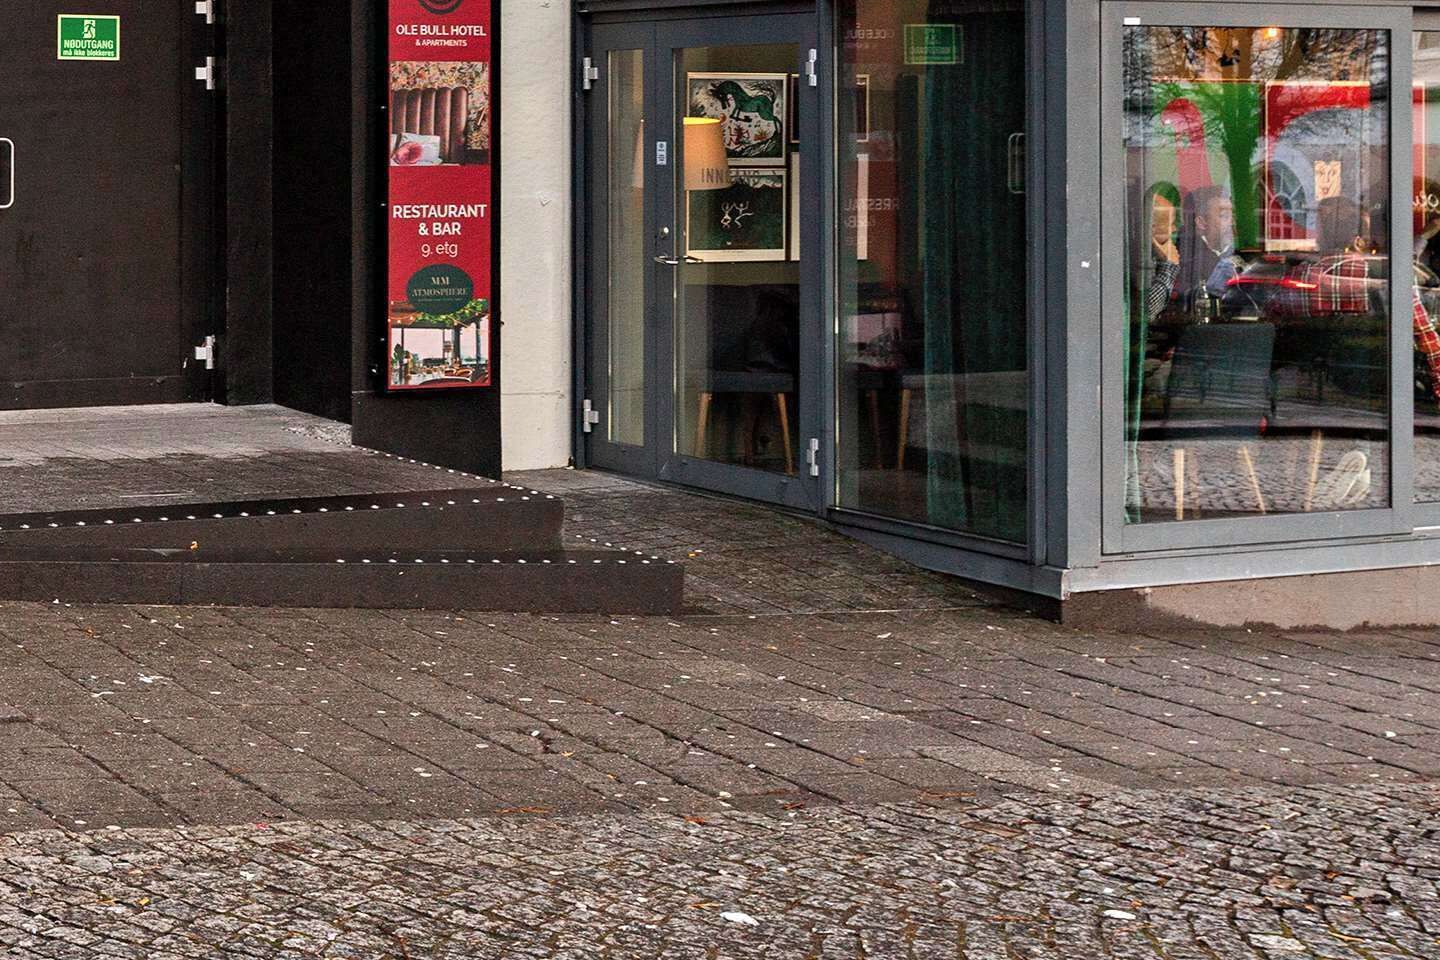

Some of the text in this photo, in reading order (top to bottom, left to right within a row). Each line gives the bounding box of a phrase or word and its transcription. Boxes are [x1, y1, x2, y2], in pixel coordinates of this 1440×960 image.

[395, 24, 487, 36] OLE BULL HOTEL
[63, 39, 114, 49] NØDUTGANG
[421, 39, 468, 47] APARTMENTS
[392, 204, 488, 219] RESTAURANT
[418, 222, 462, 236] & BAR
[435, 241, 458, 258] etg
[431, 276, 450, 286] MM
[412, 287, 467, 297] ATMOSPHERE
